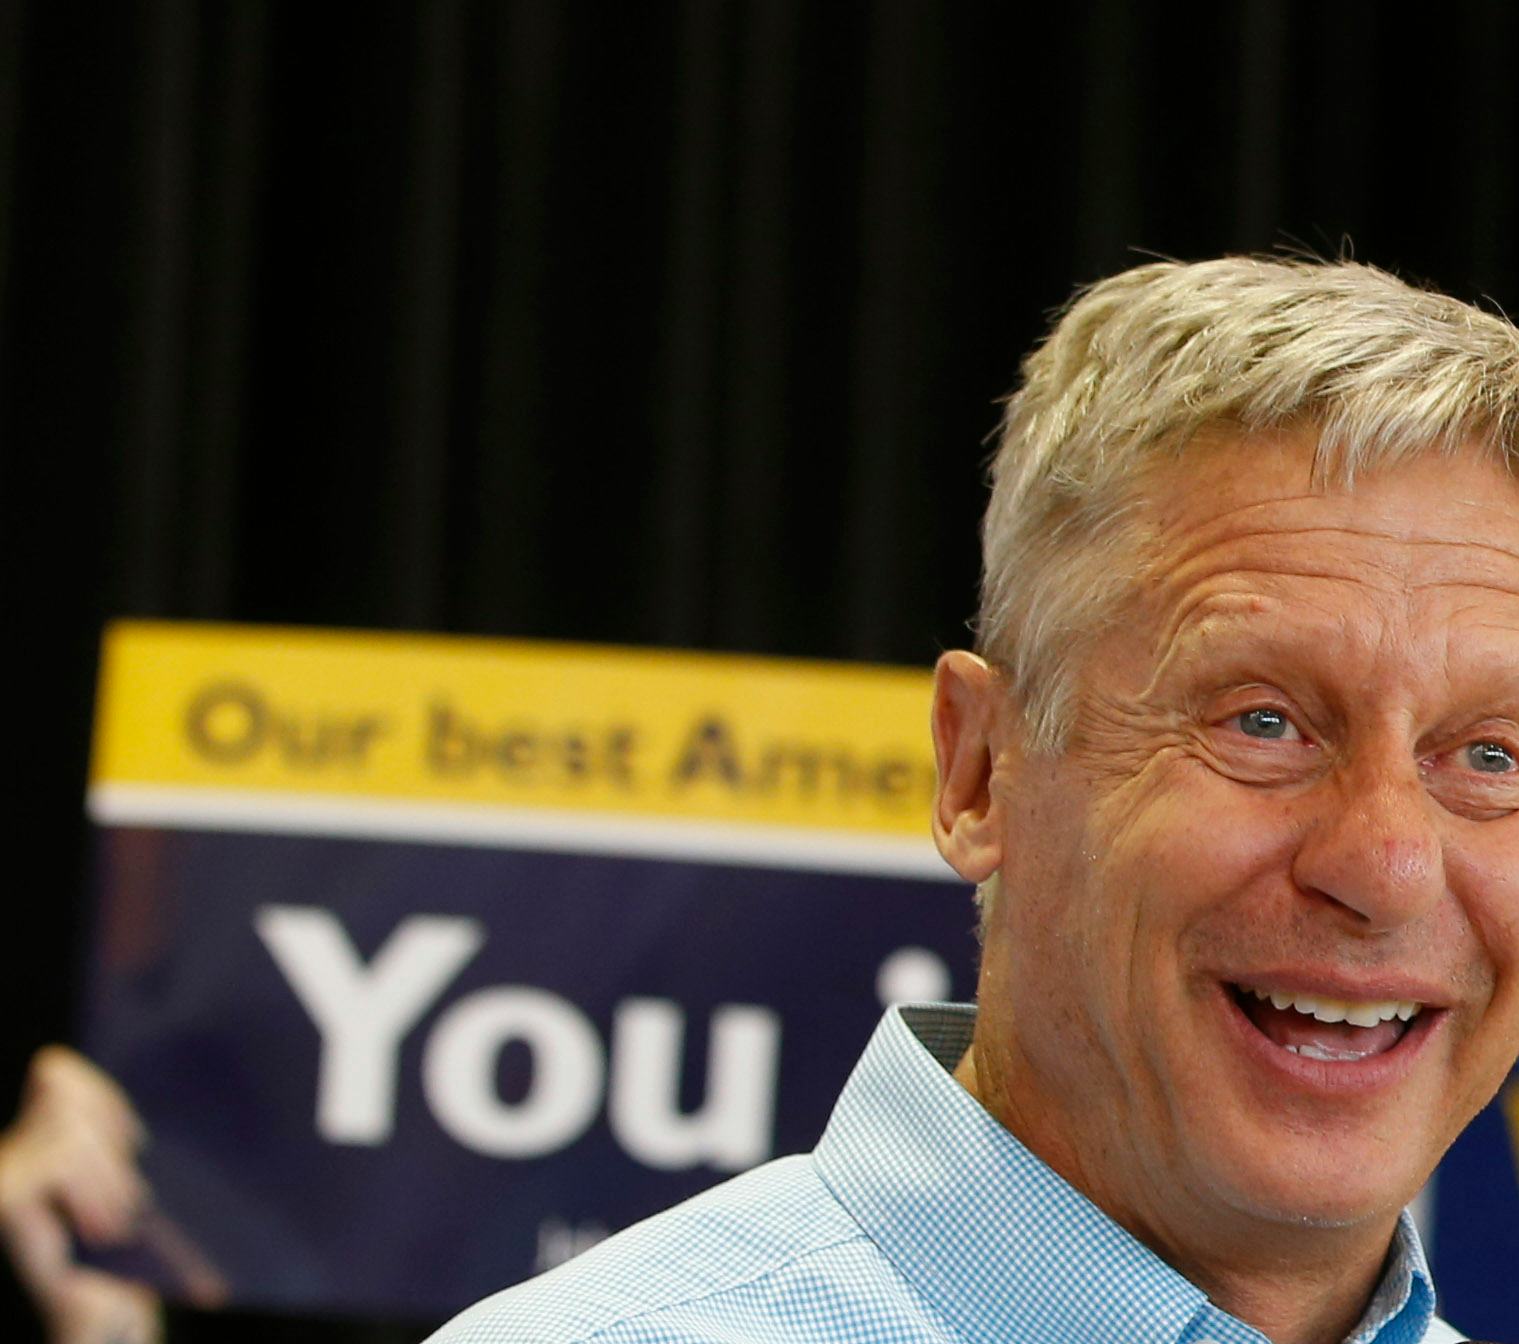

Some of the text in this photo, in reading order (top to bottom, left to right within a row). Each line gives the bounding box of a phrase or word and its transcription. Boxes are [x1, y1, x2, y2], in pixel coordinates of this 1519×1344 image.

[183, 680, 937, 808] Our best Ame
[253, 904, 783, 1172] You
